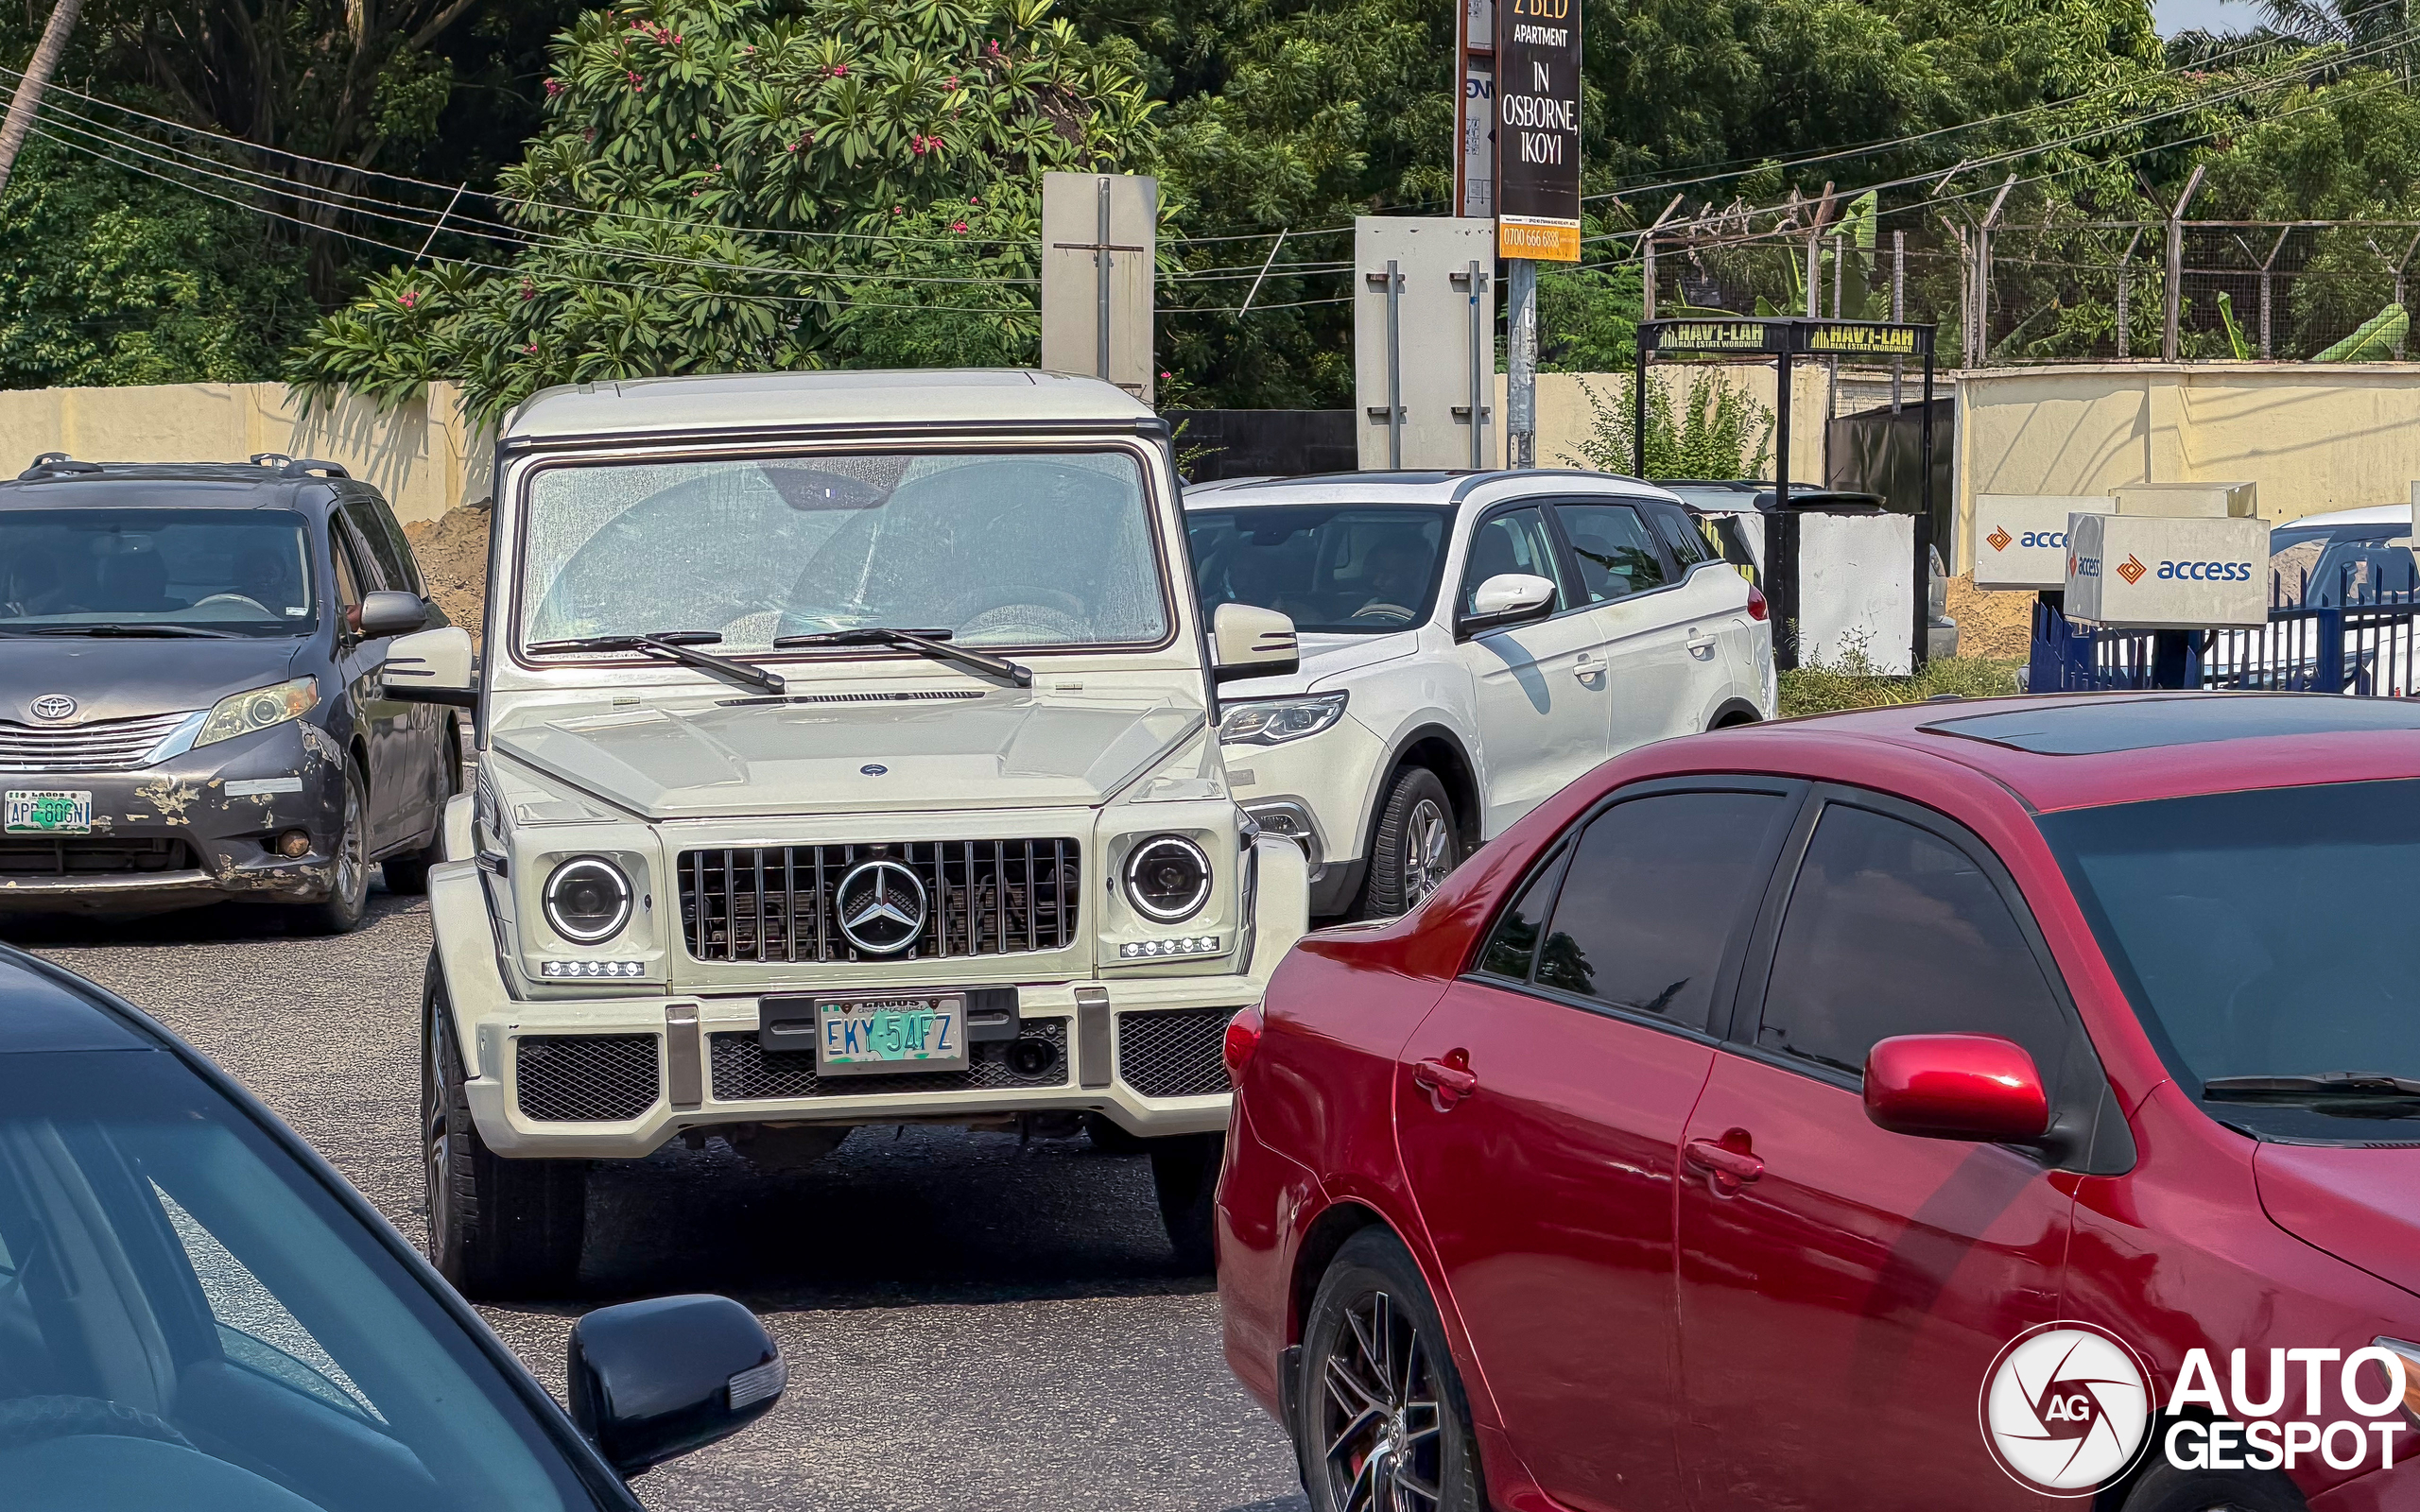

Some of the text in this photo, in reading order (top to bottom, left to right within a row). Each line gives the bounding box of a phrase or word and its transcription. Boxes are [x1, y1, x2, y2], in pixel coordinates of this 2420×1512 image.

[1513, 24, 1568, 47] APARTMENT
[1533, 60, 1549, 93] IN
[1502, 94, 1579, 136] OSBORNE,
[1520, 131, 1563, 165] IKOYI
[1503, 227, 1525, 246] 0700
[1847, 343, 1872, 352] ESTATE
[2078, 556, 2100, 577] access
[2156, 559, 2252, 582] access
